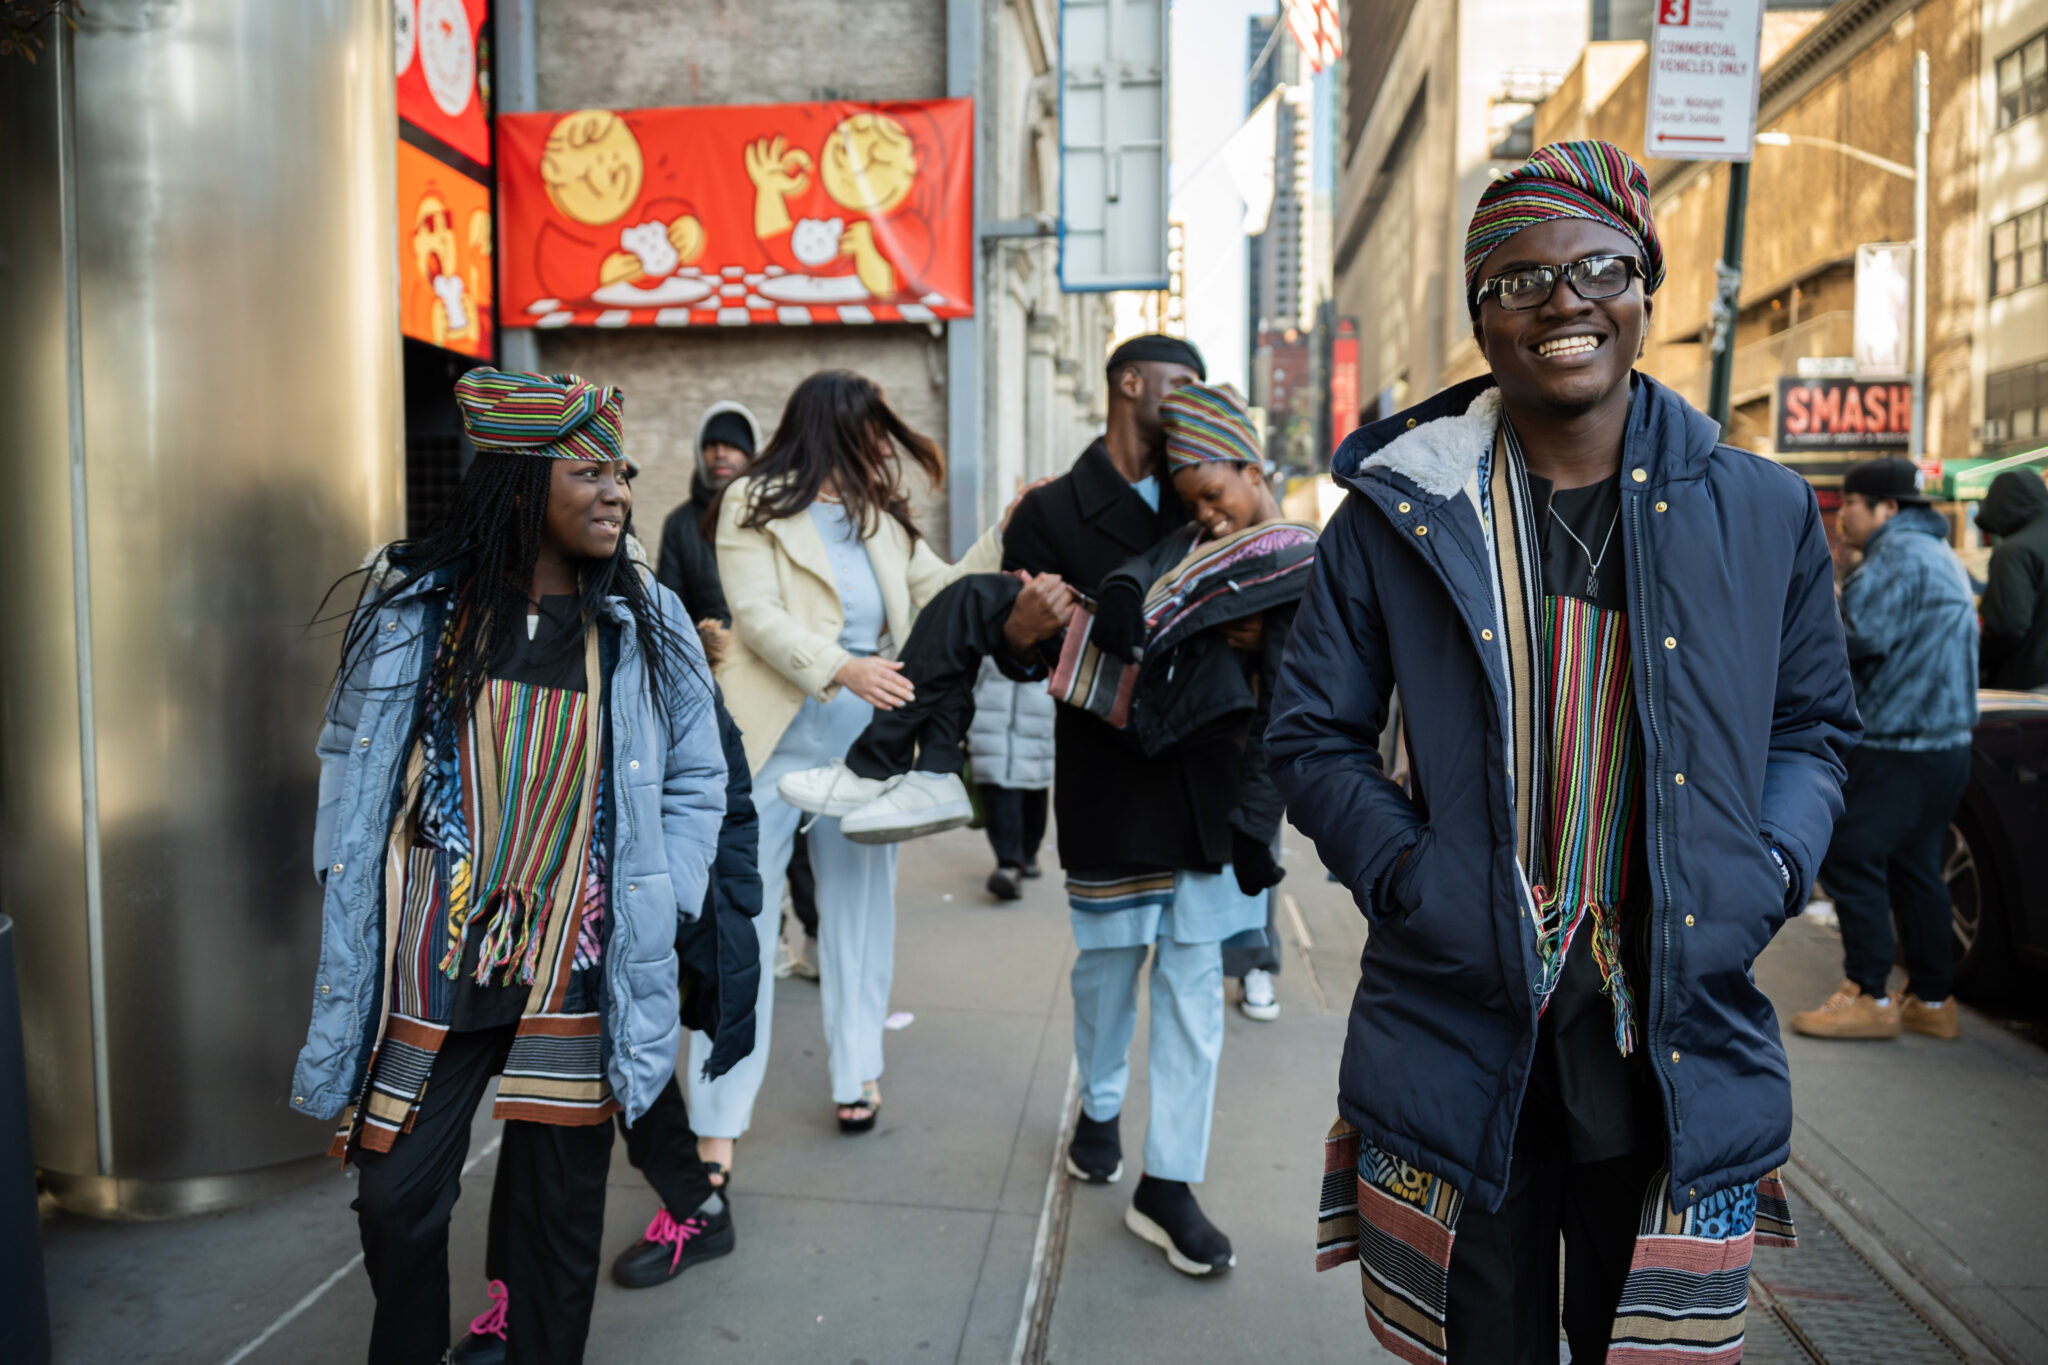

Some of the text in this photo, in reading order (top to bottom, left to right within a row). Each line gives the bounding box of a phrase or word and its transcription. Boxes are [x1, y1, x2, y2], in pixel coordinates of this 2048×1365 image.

[1665, 0, 1685, 24] 3
[1659, 40, 1737, 58] COMMERCIAL
[1660, 59, 1748, 77] VEHICLES ONLY
[1785, 386, 1911, 434] SMASH
